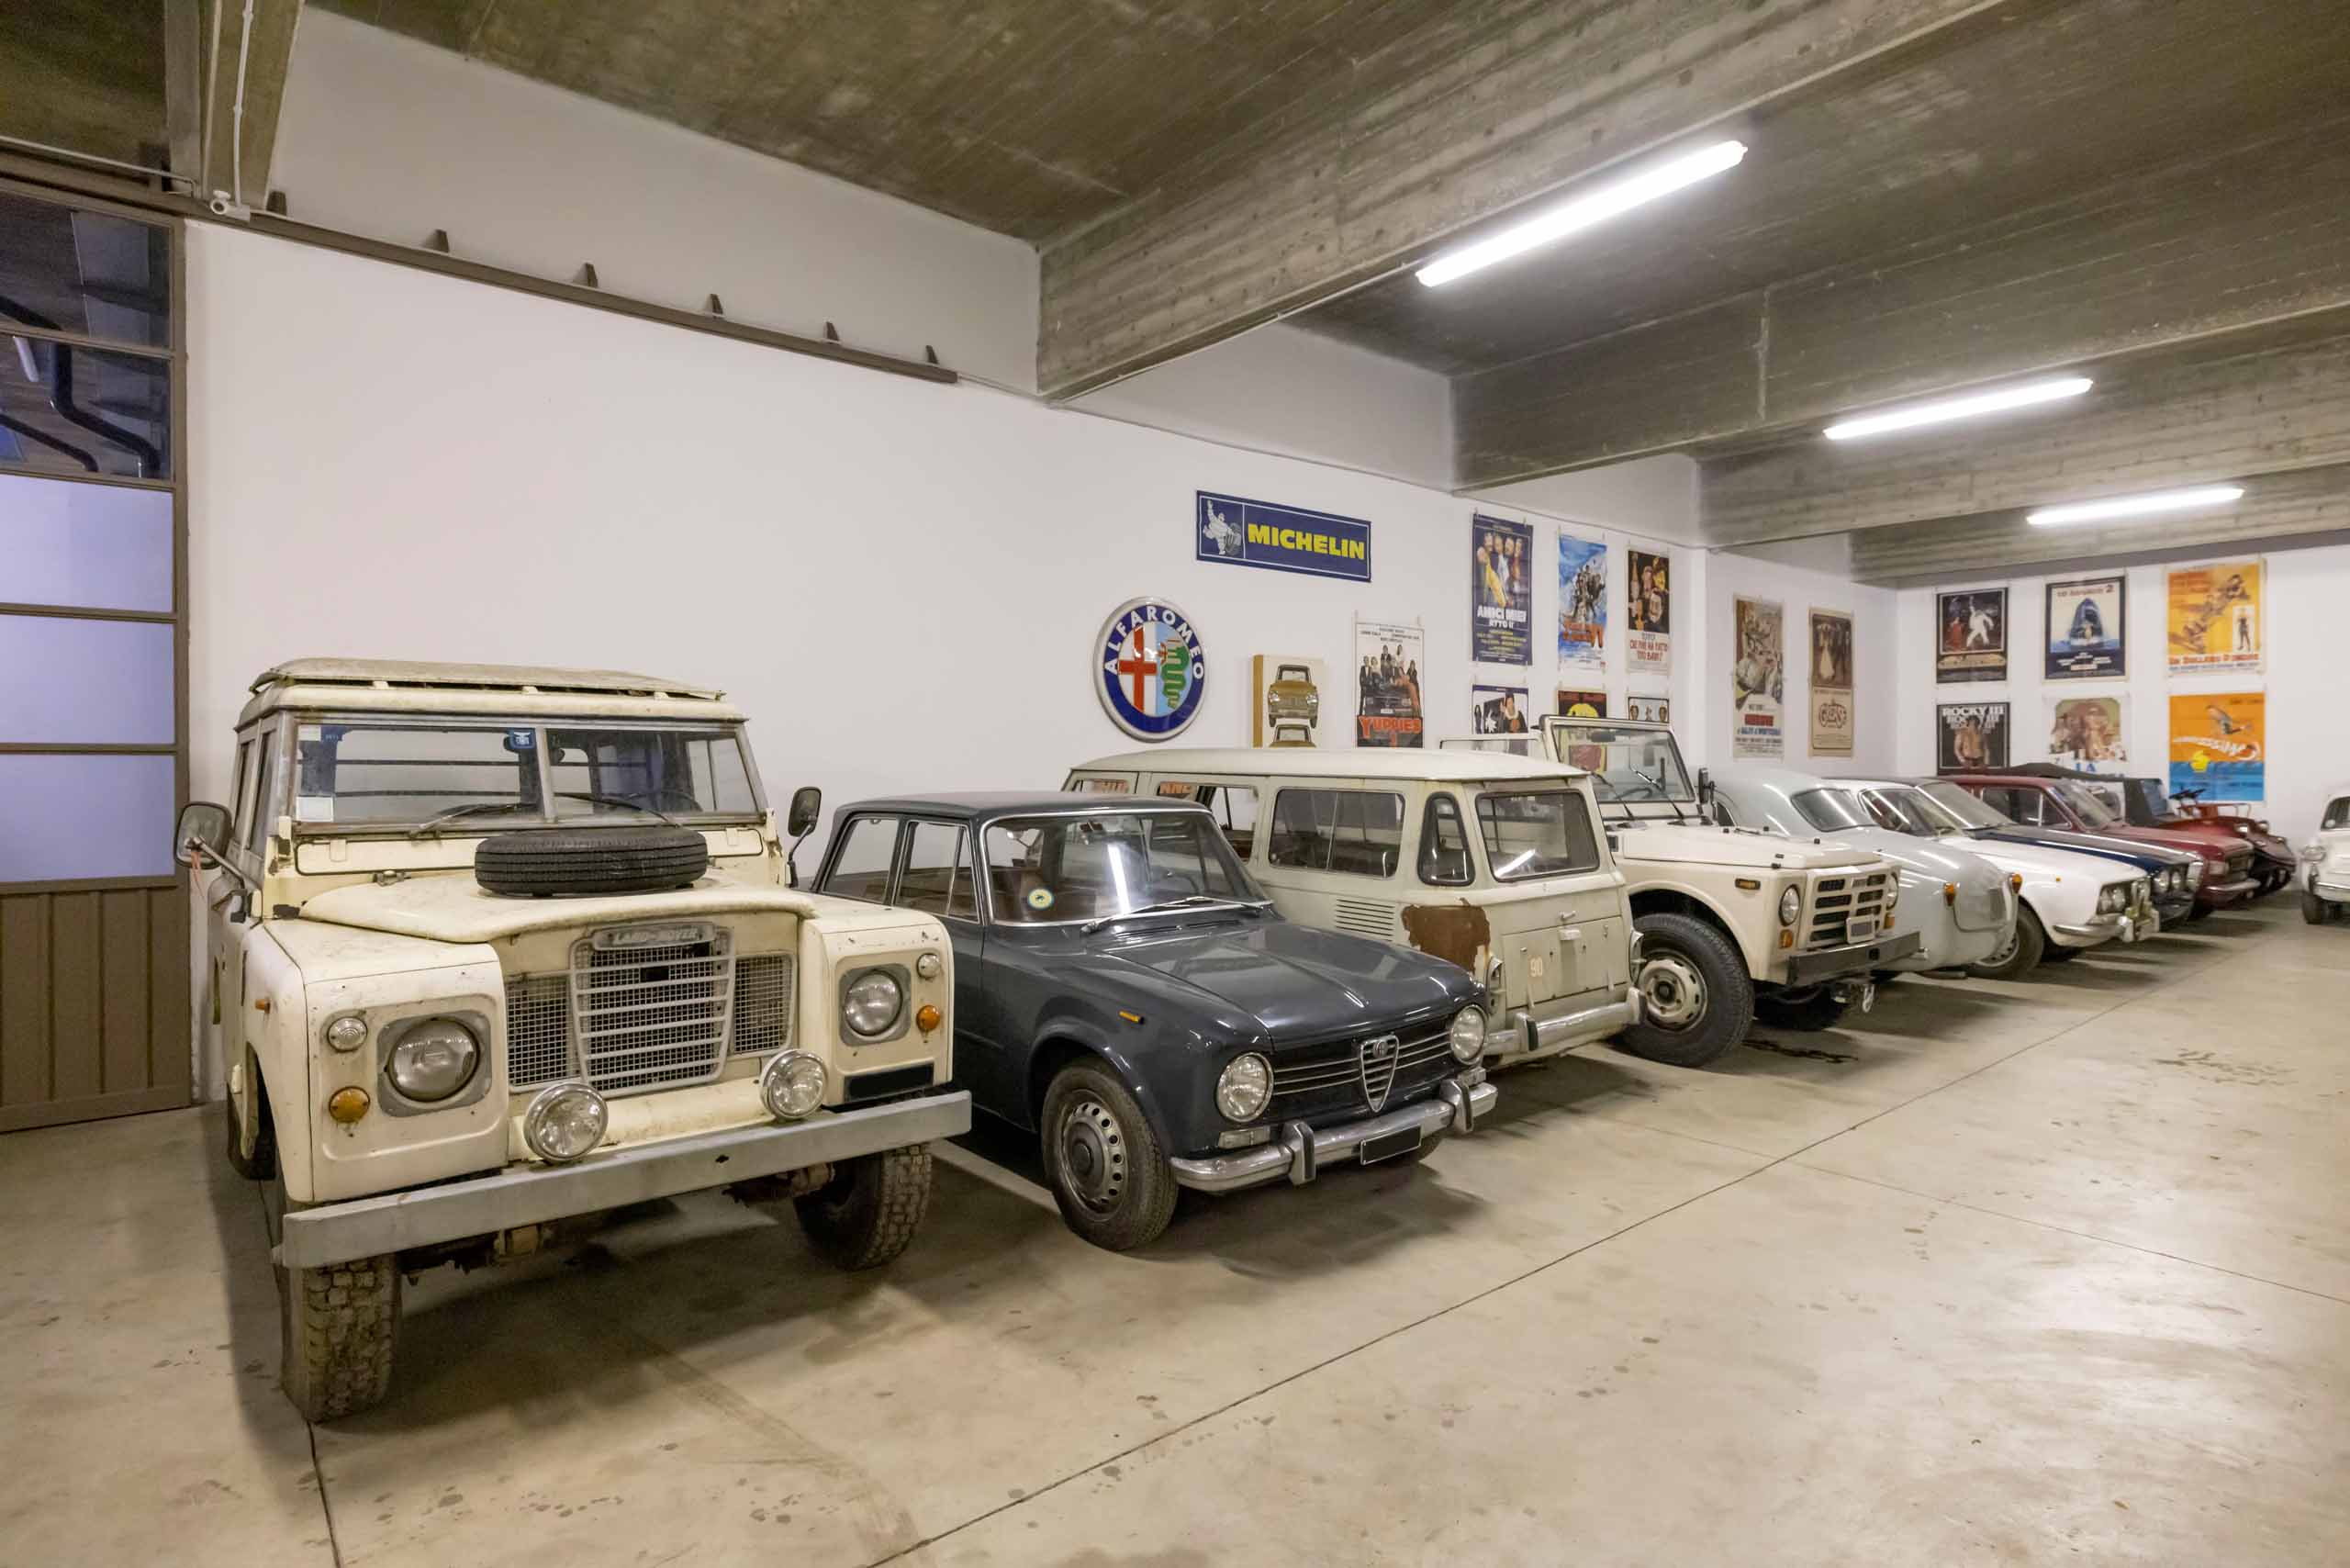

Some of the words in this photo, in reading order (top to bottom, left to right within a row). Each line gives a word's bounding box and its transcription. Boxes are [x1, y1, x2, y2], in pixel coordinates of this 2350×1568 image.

[1248, 523, 1365, 559] MICHELIN
[1942, 706, 1985, 717] ROCKY
[1987, 705, 2005, 715] III
[1529, 957, 1543, 978] 90
